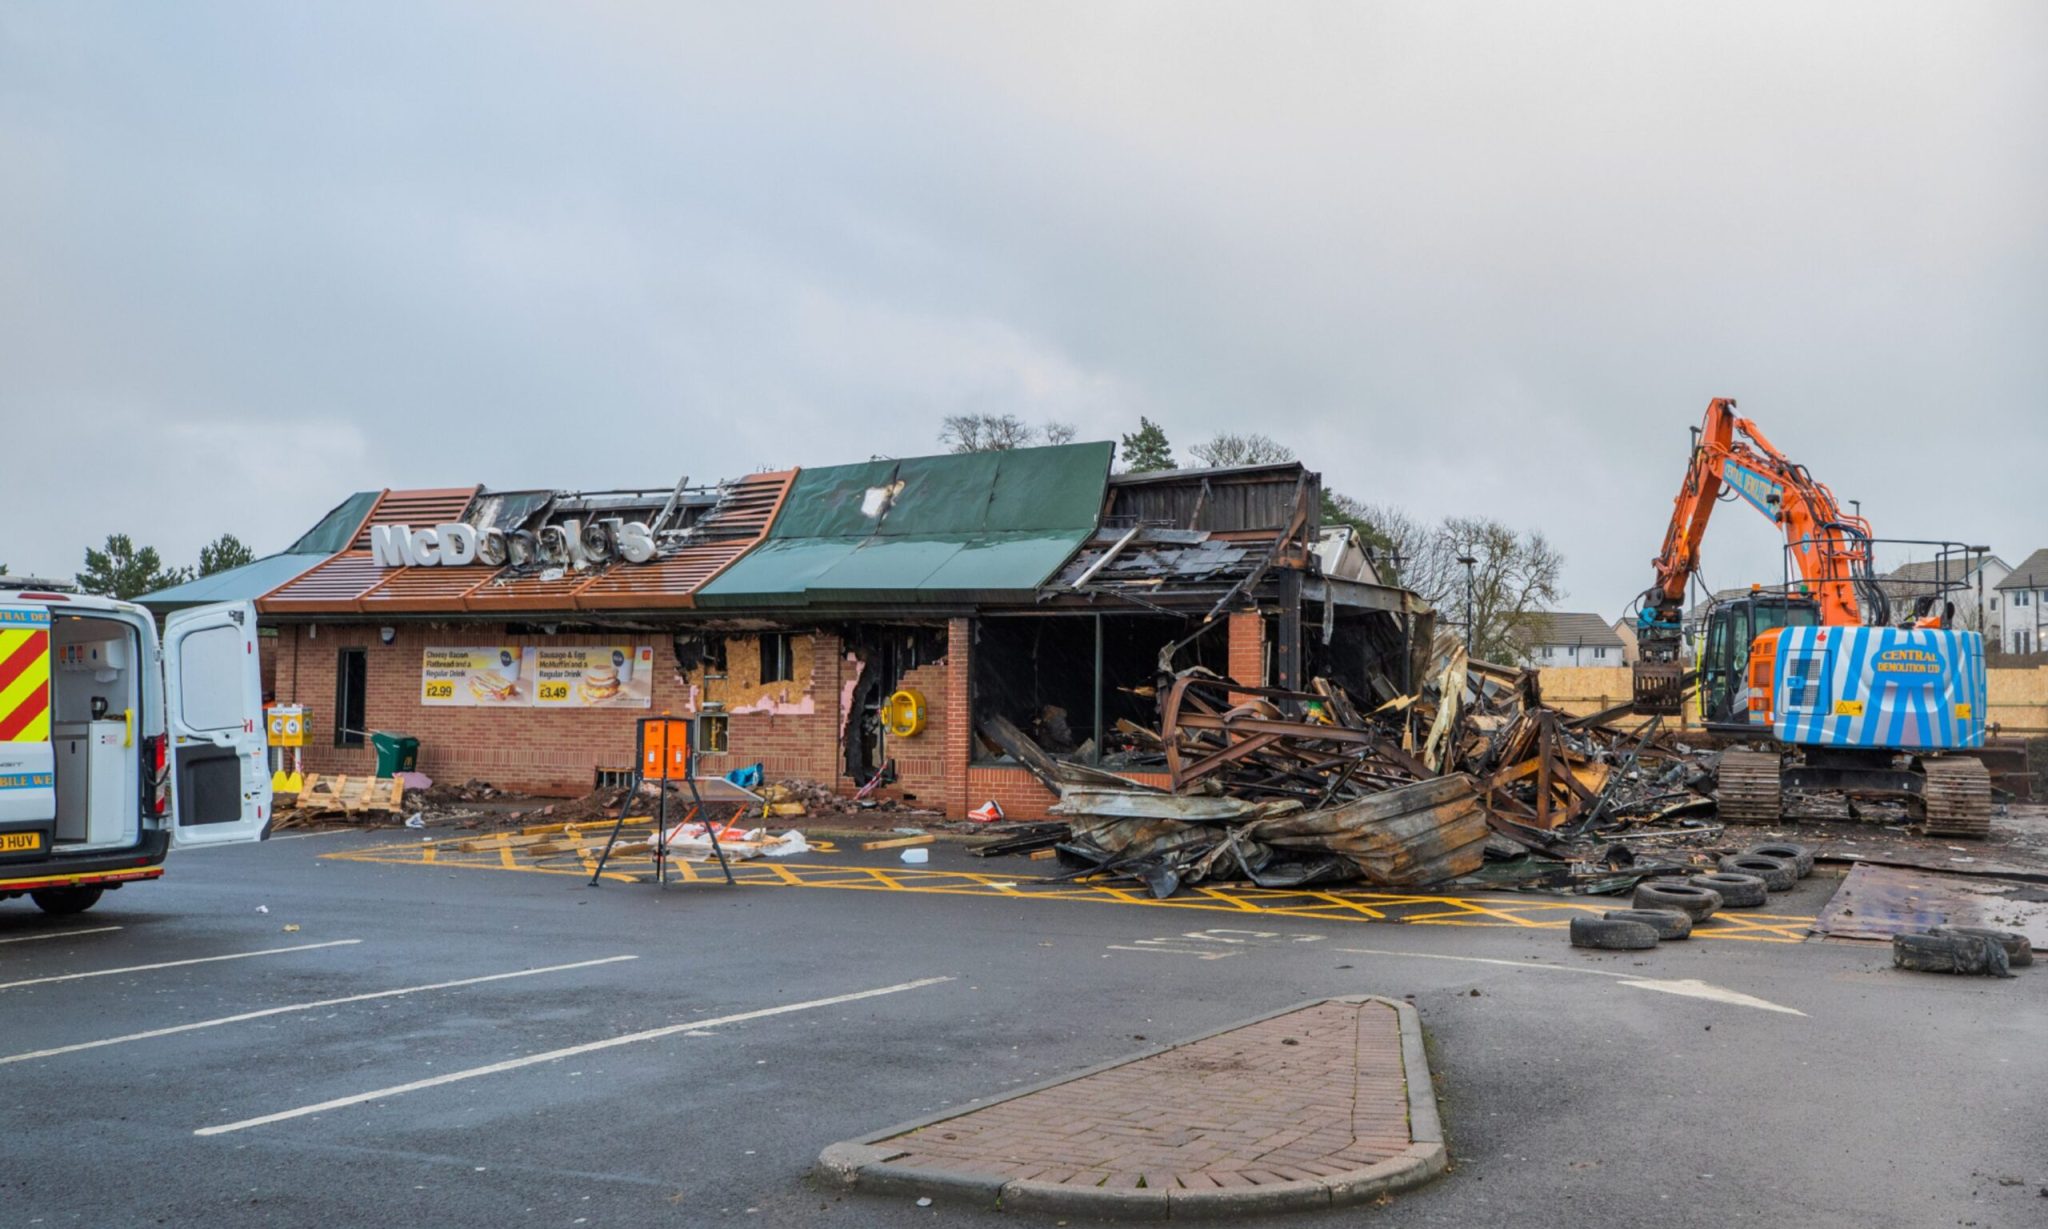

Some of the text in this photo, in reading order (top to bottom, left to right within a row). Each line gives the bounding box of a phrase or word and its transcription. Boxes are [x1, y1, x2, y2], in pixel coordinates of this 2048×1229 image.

[426, 651, 469, 659] Cheesy Bacon
[539, 651, 567, 660] Sausage
[574, 651, 586, 660] Egg
[1881, 650, 1938, 661] CENTRAL
[426, 660, 454, 668] Flatbread
[455, 660, 466, 668] and
[571, 660, 582, 668] and
[1878, 662, 1926, 673] DEMOLITION
[426, 669, 466, 679] Regular Drink
[539, 670, 582, 679] Regular Drink
[426, 686, 452, 697] £2.99
[540, 687, 567, 698] £3.49
[7, 834, 33, 848] HUV
